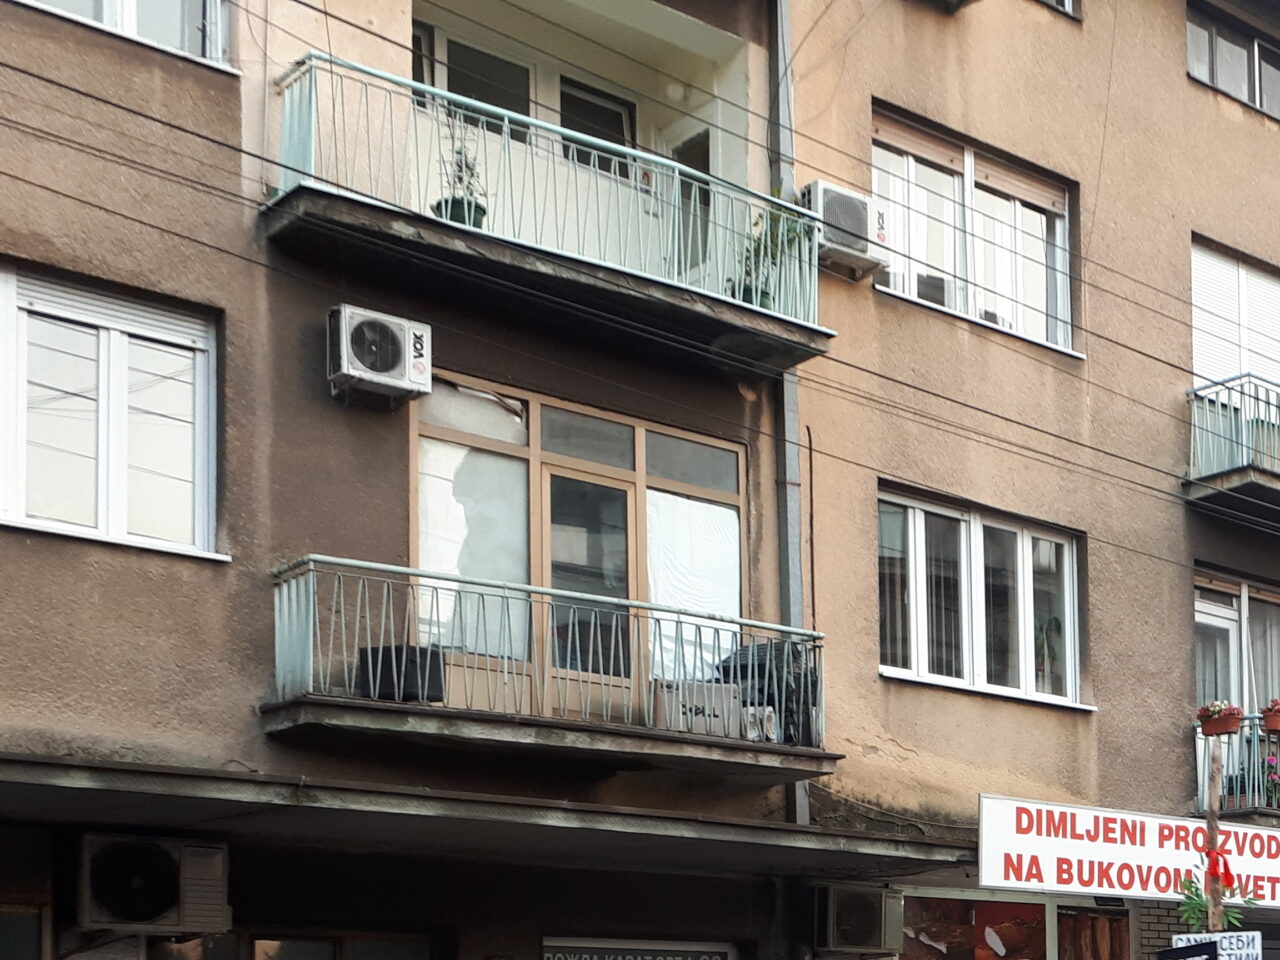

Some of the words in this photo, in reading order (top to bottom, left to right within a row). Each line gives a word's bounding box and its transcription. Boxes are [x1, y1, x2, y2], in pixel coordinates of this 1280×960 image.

[413, 331, 425, 360] VOX
[1015, 806, 1146, 847] DIMLJENI
[1003, 853, 1044, 883] NA
[1056, 858, 1193, 894] BUKOVOM
[1219, 934, 1256, 951] СЕБИ
